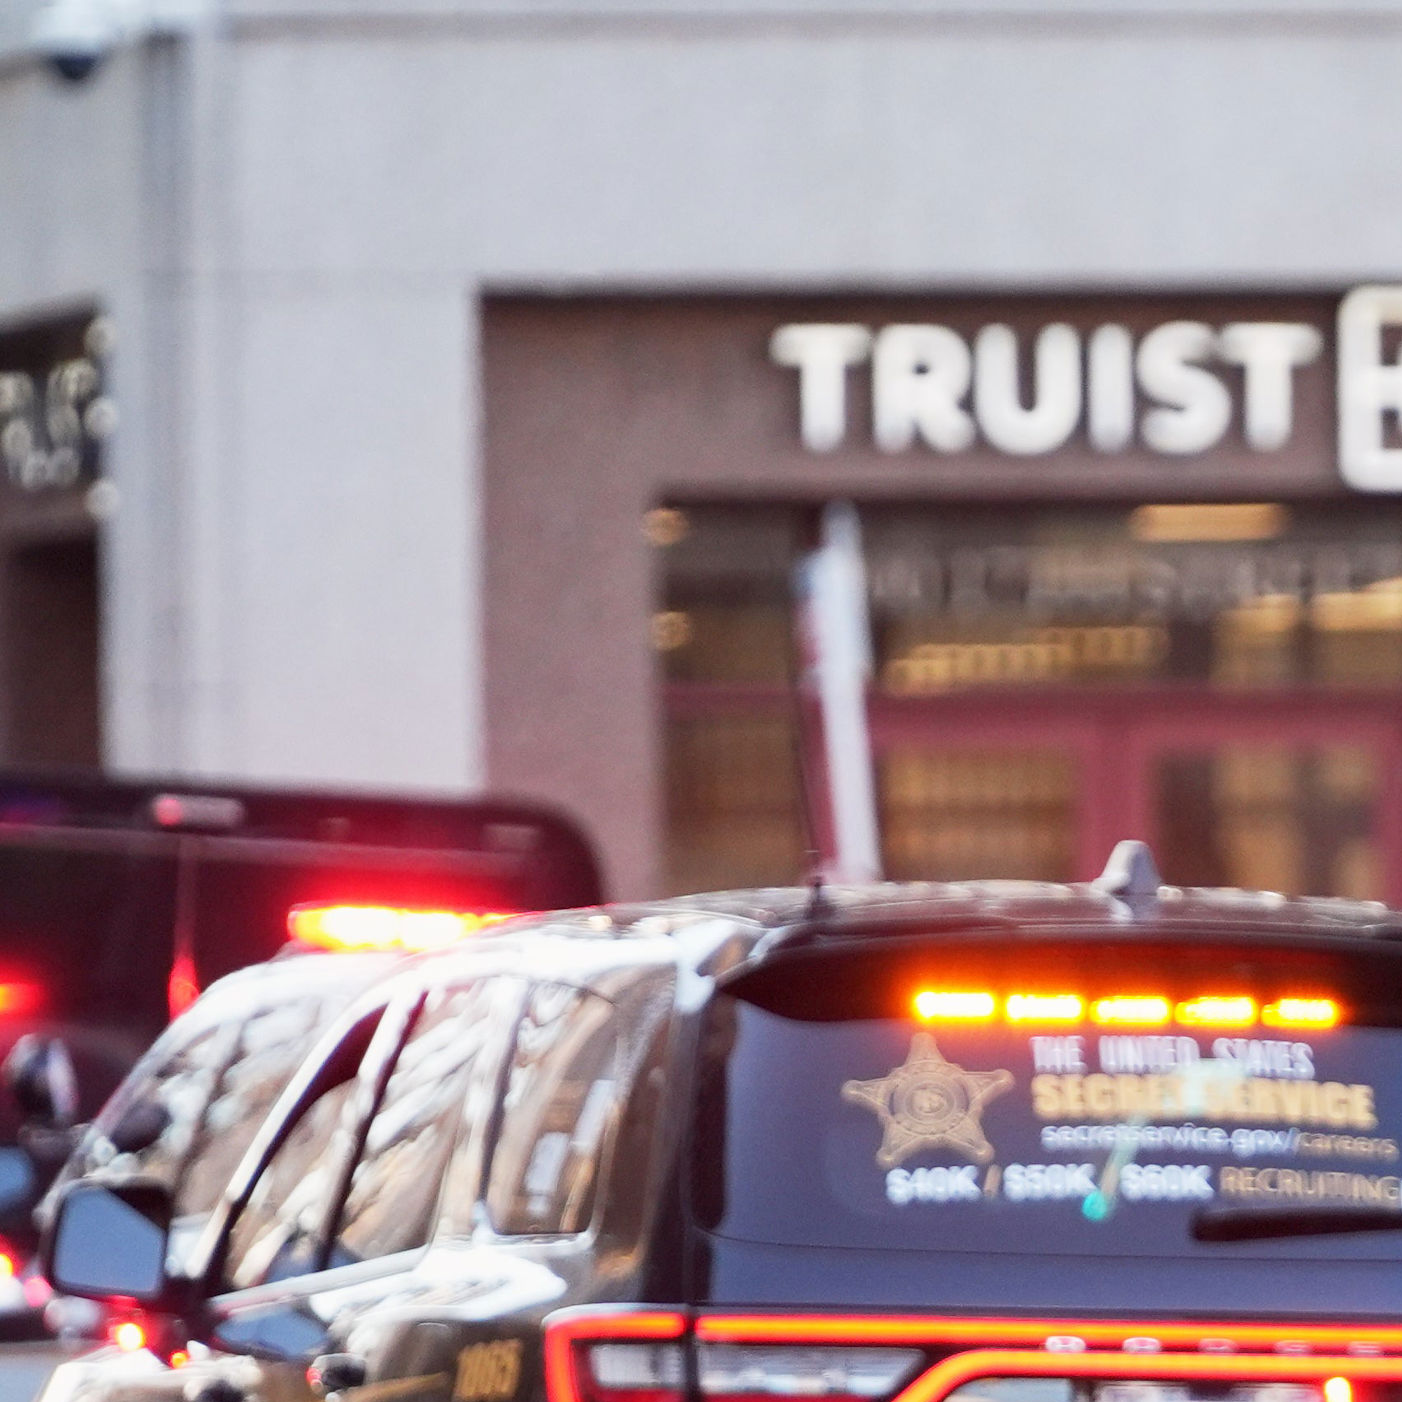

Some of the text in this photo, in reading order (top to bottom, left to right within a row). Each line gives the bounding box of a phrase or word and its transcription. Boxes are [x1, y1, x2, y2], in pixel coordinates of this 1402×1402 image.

[769, 321, 1323, 455] TRUIST
[1212, 1037, 1316, 1080] STATES
[1031, 1074, 1197, 1122] SECRE
[1219, 1166, 1400, 1205] RECRUITING
